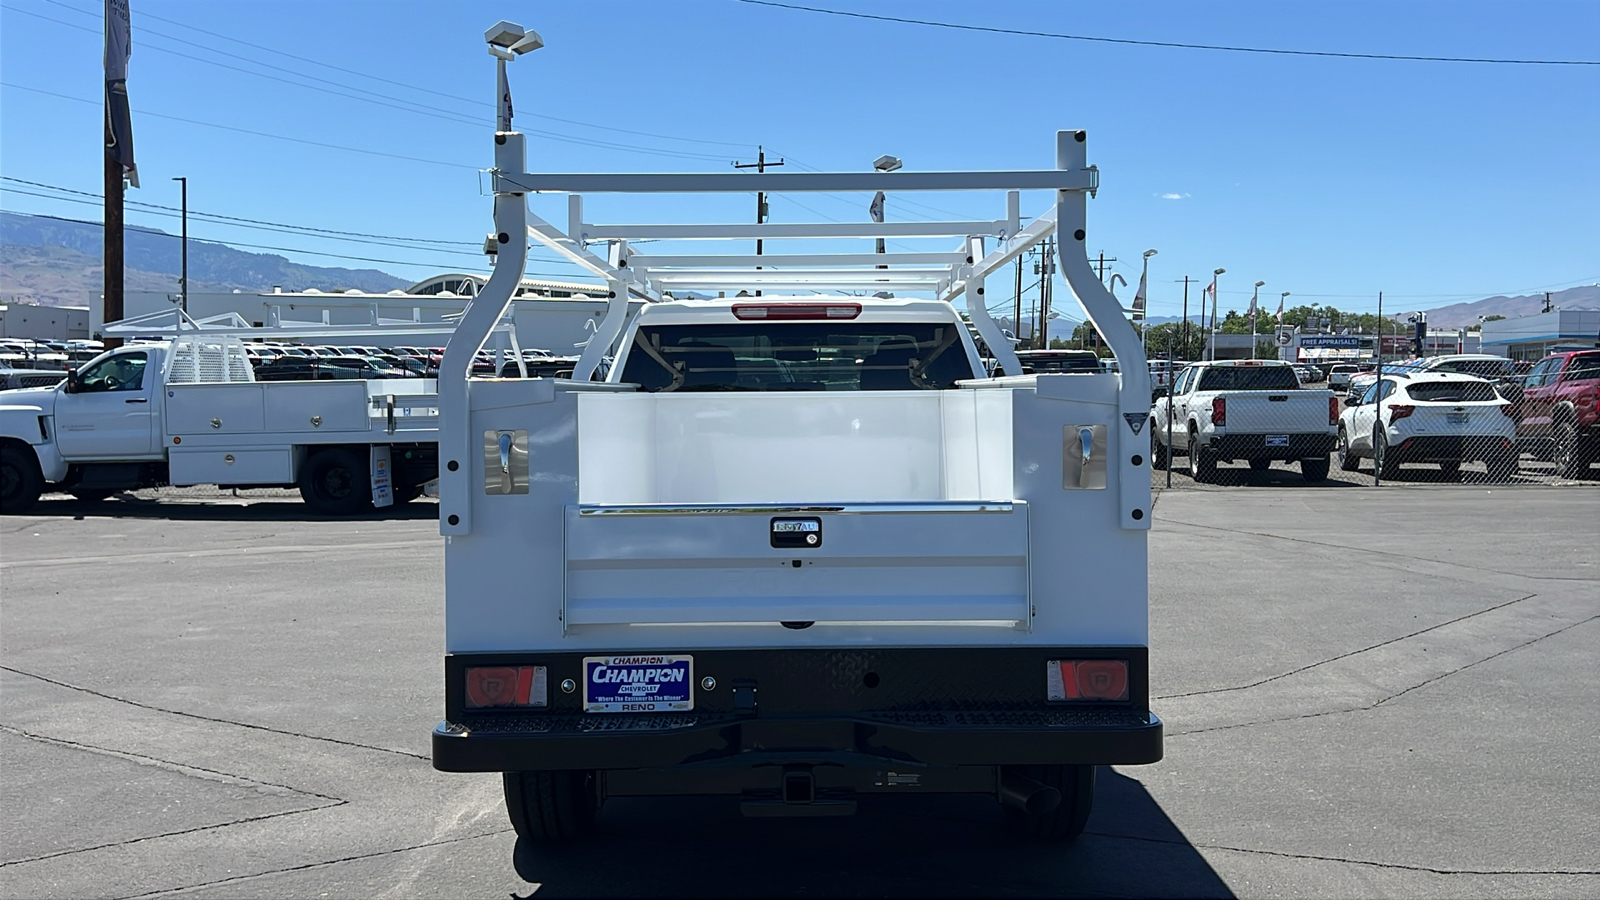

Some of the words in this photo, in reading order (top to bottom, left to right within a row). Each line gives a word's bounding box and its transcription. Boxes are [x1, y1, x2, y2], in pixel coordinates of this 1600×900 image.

[612, 657, 664, 665] CHAMPION
[592, 666, 685, 683] CHAMPION
[622, 703, 656, 711] RENO
